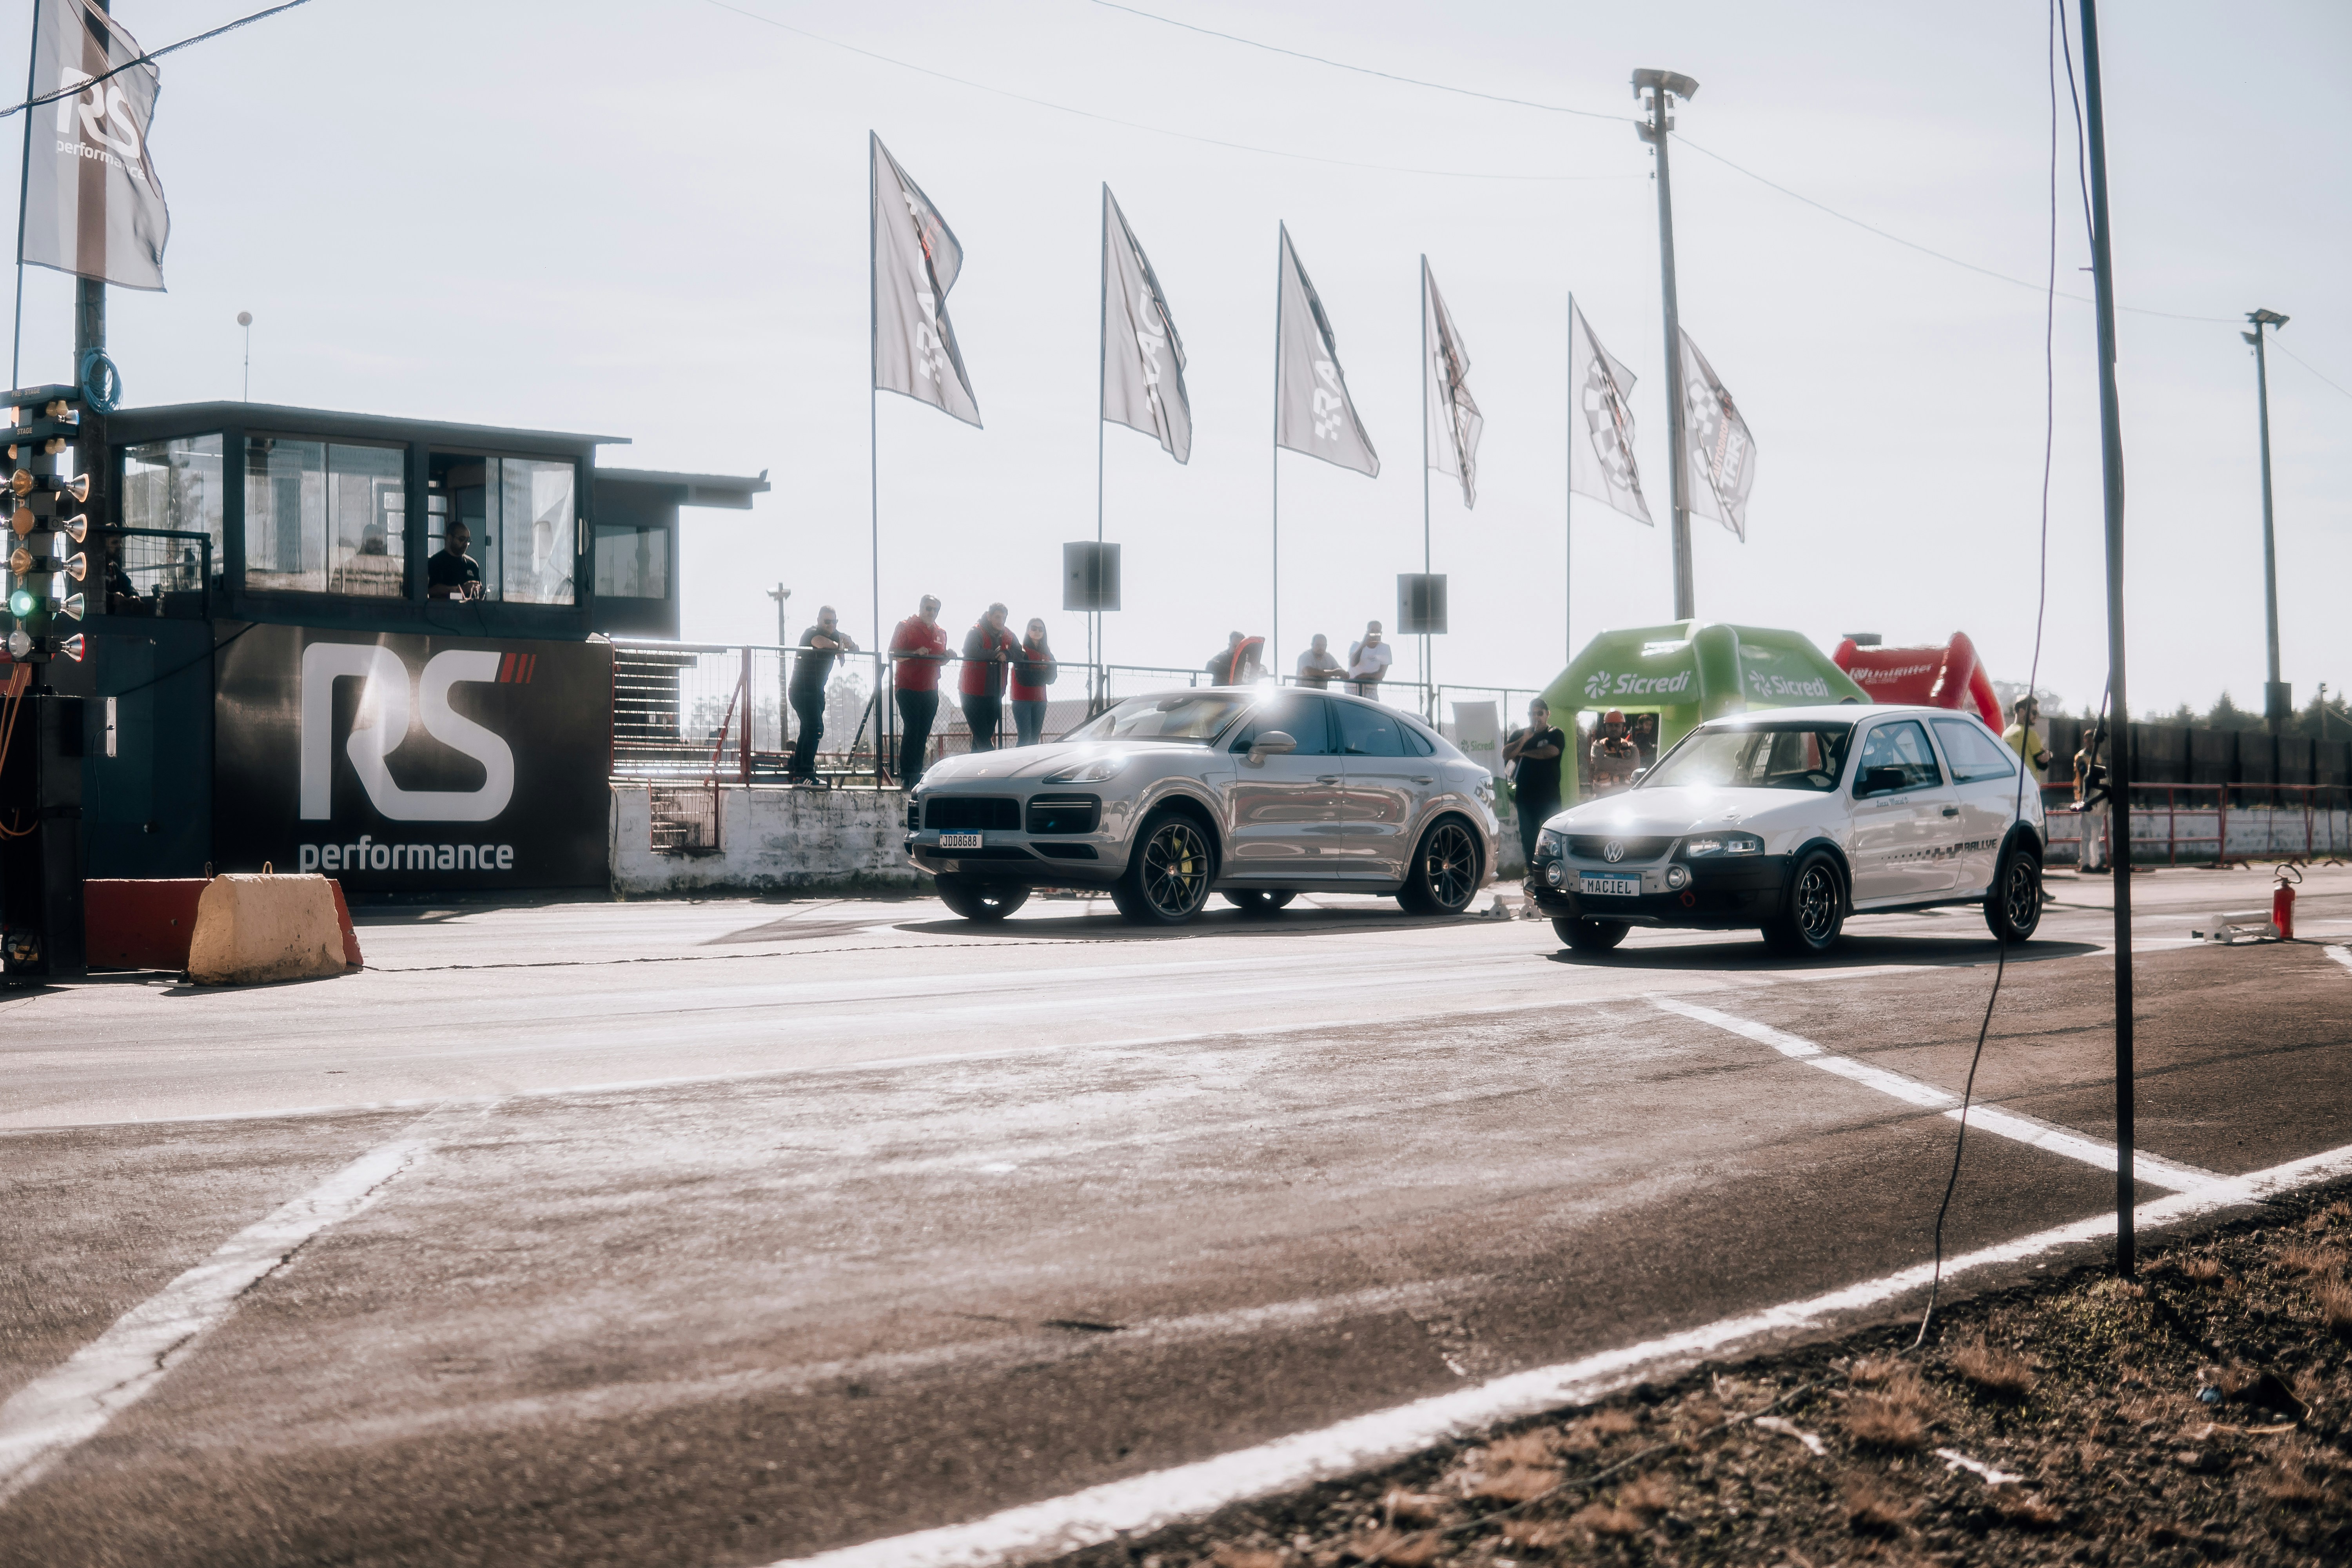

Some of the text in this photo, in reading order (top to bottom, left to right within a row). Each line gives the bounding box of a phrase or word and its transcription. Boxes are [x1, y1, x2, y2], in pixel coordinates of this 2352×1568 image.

[56, 140, 145, 181] performance
[17, 427, 33, 435] STAGE
[1613, 671, 1691, 694] Sicredi
[1770, 675, 1829, 697] Sicredi
[300, 642, 514, 822] RS
[1470, 740, 1494, 751] Sicredi
[943, 835, 977, 846] JDD8G88
[1964, 838, 1998, 851] RALLYE
[299, 835, 514, 874] performance
[1588, 880, 1631, 894] MACIEL
